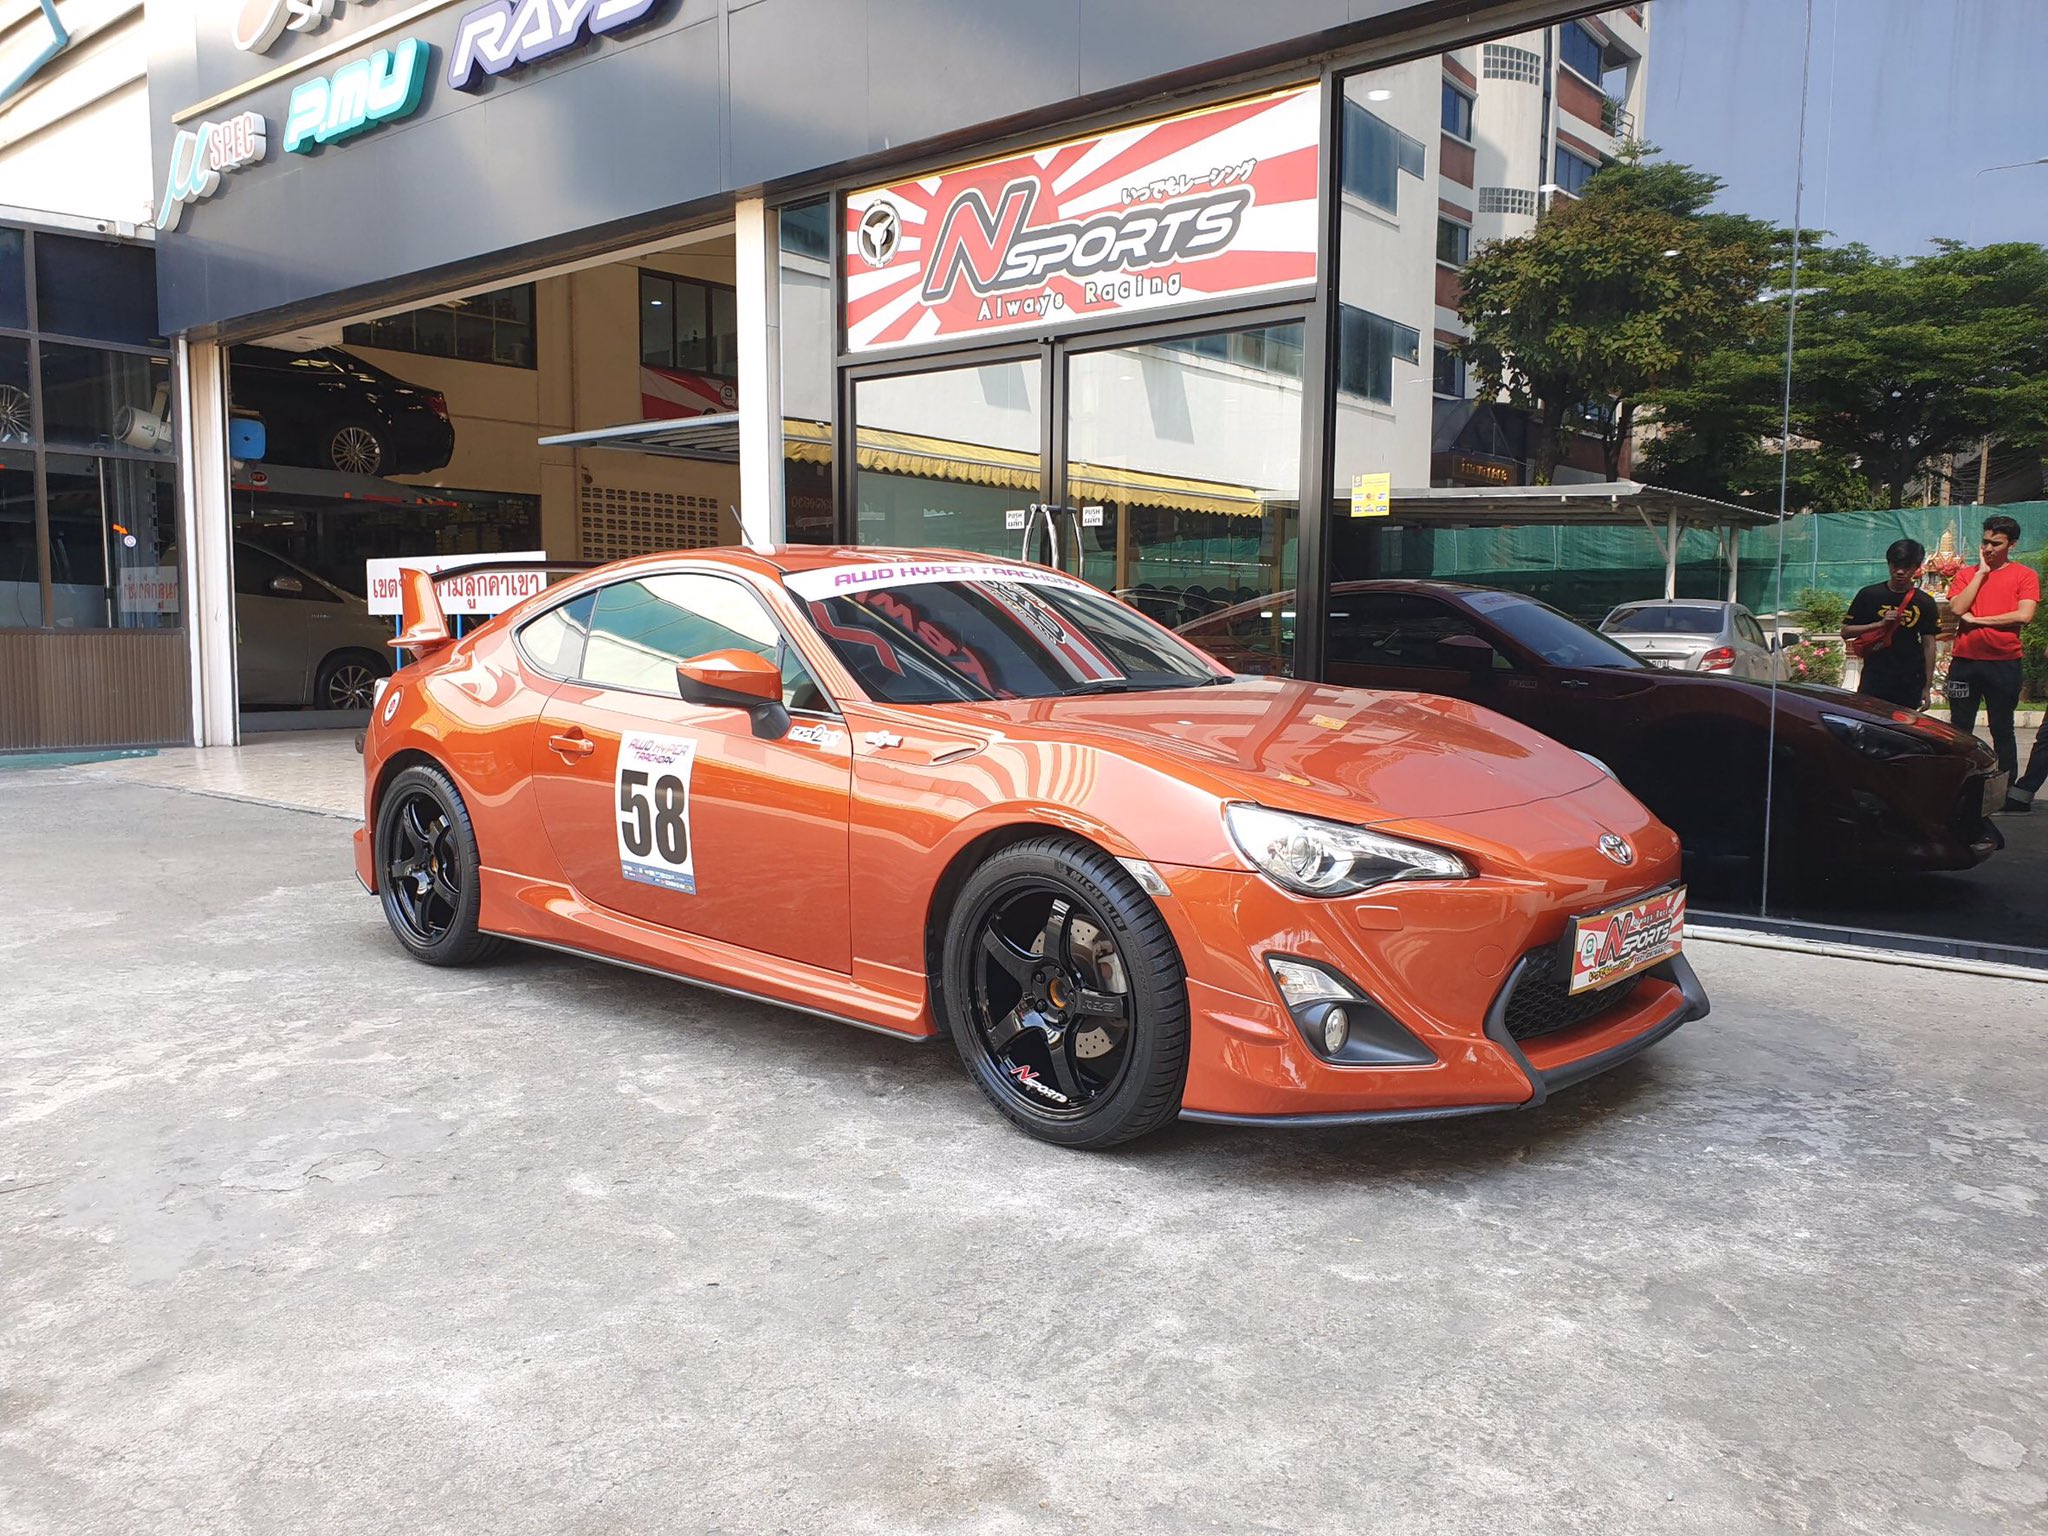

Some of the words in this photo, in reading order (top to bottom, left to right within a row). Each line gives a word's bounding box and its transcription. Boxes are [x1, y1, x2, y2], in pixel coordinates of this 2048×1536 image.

[209, 114, 256, 171] SPEC
[977, 293, 1065, 322] Always
[1084, 273, 1182, 305] Racing
[834, 567, 895, 588] AWD
[899, 564, 976, 578] HYPER
[628, 738, 655, 752] AWD
[652, 742, 691, 757] HYPER
[620, 768, 688, 865] 58
[1069, 871, 1128, 931] MICHELIN
